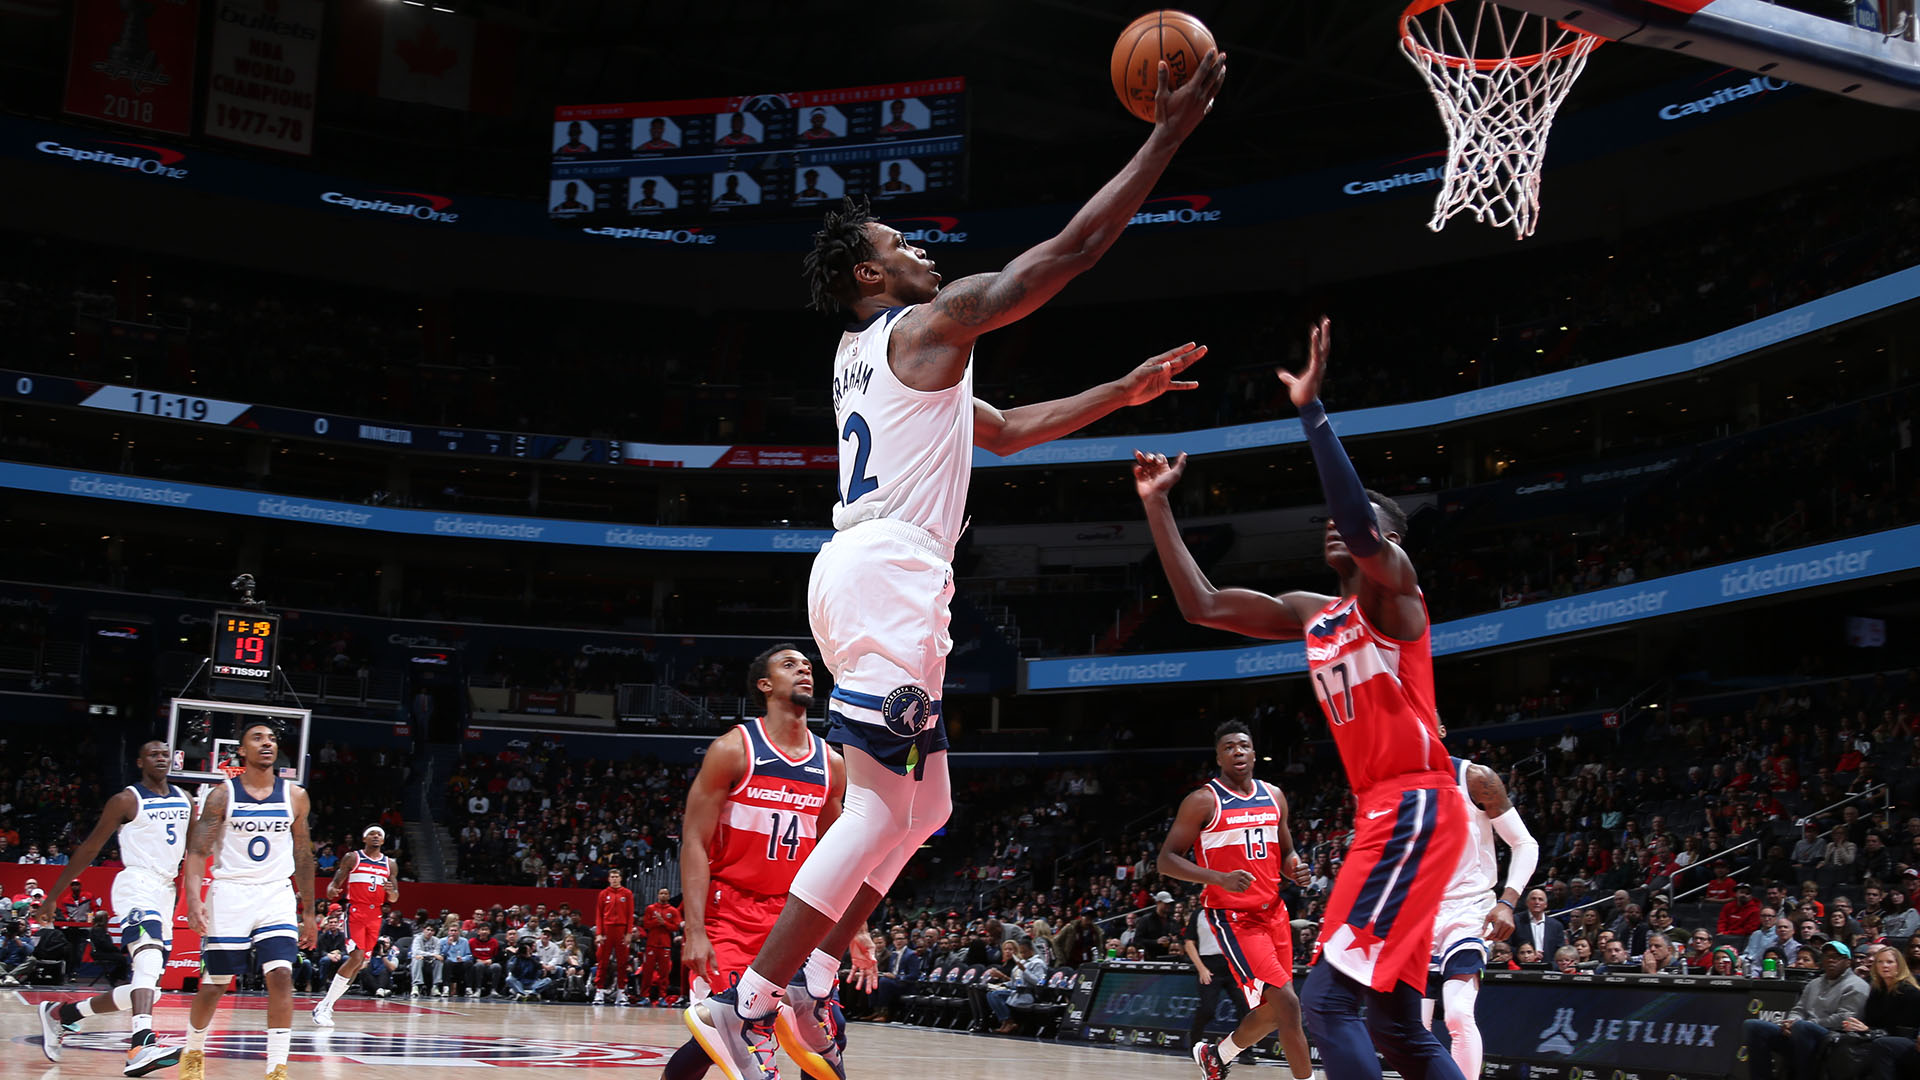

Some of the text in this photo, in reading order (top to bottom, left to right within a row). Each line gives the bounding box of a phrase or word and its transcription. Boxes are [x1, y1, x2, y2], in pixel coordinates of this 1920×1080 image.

[103, 94, 153, 123] 2018
[216, 104, 303, 142] 1977-78
[1693, 309, 1815, 365] ticketmaster
[16, 378, 33, 395] 0
[132, 391, 208, 421] 11:19
[313, 418, 329, 435] 0
[69, 476, 192, 505] ticketmaster
[258, 497, 373, 526] ticketmaster
[433, 516, 545, 540] ticketmaster
[605, 528, 713, 550] ticketmaster
[1720, 548, 1874, 597] ticketmaster
[1545, 588, 1669, 631] ticketmaster
[235, 637, 265, 664] 19
[230, 667, 271, 677] TISSOT
[1068, 660, 1188, 684] ticketmaster
[1316, 662, 1356, 726] 17
[746, 785, 824, 810] washington
[147, 810, 189, 820] WOLVES
[231, 821, 290, 833] WOLVES
[1226, 811, 1278, 825] washington
[166, 823, 177, 846] 5
[767, 812, 801, 861] 14
[1244, 828, 1268, 861] 13
[247, 835, 271, 862] 0
[368, 875, 377, 892] 3
[1587, 1018, 1721, 1047] JETLINX
